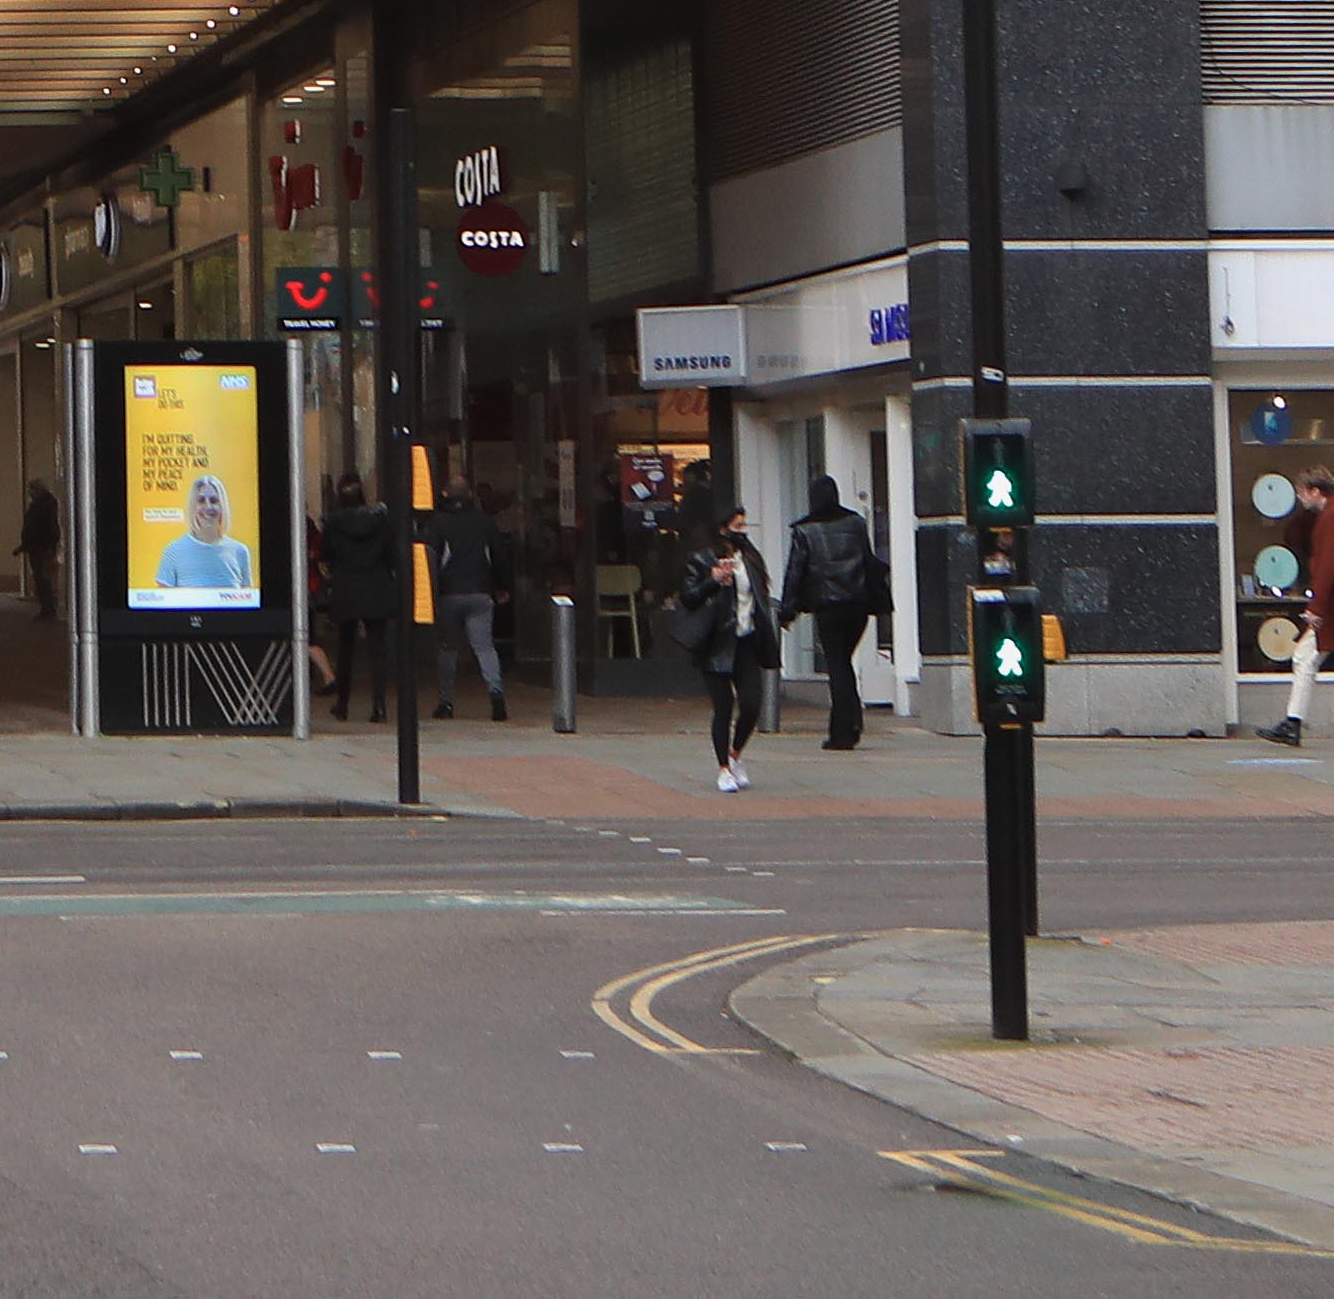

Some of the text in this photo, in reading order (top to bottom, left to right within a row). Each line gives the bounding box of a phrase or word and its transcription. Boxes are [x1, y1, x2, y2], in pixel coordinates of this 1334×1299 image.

[455, 146, 500, 208] COSTA
[461, 231, 524, 249] COSTA
[654, 355, 731, 371] SAMSUNG
